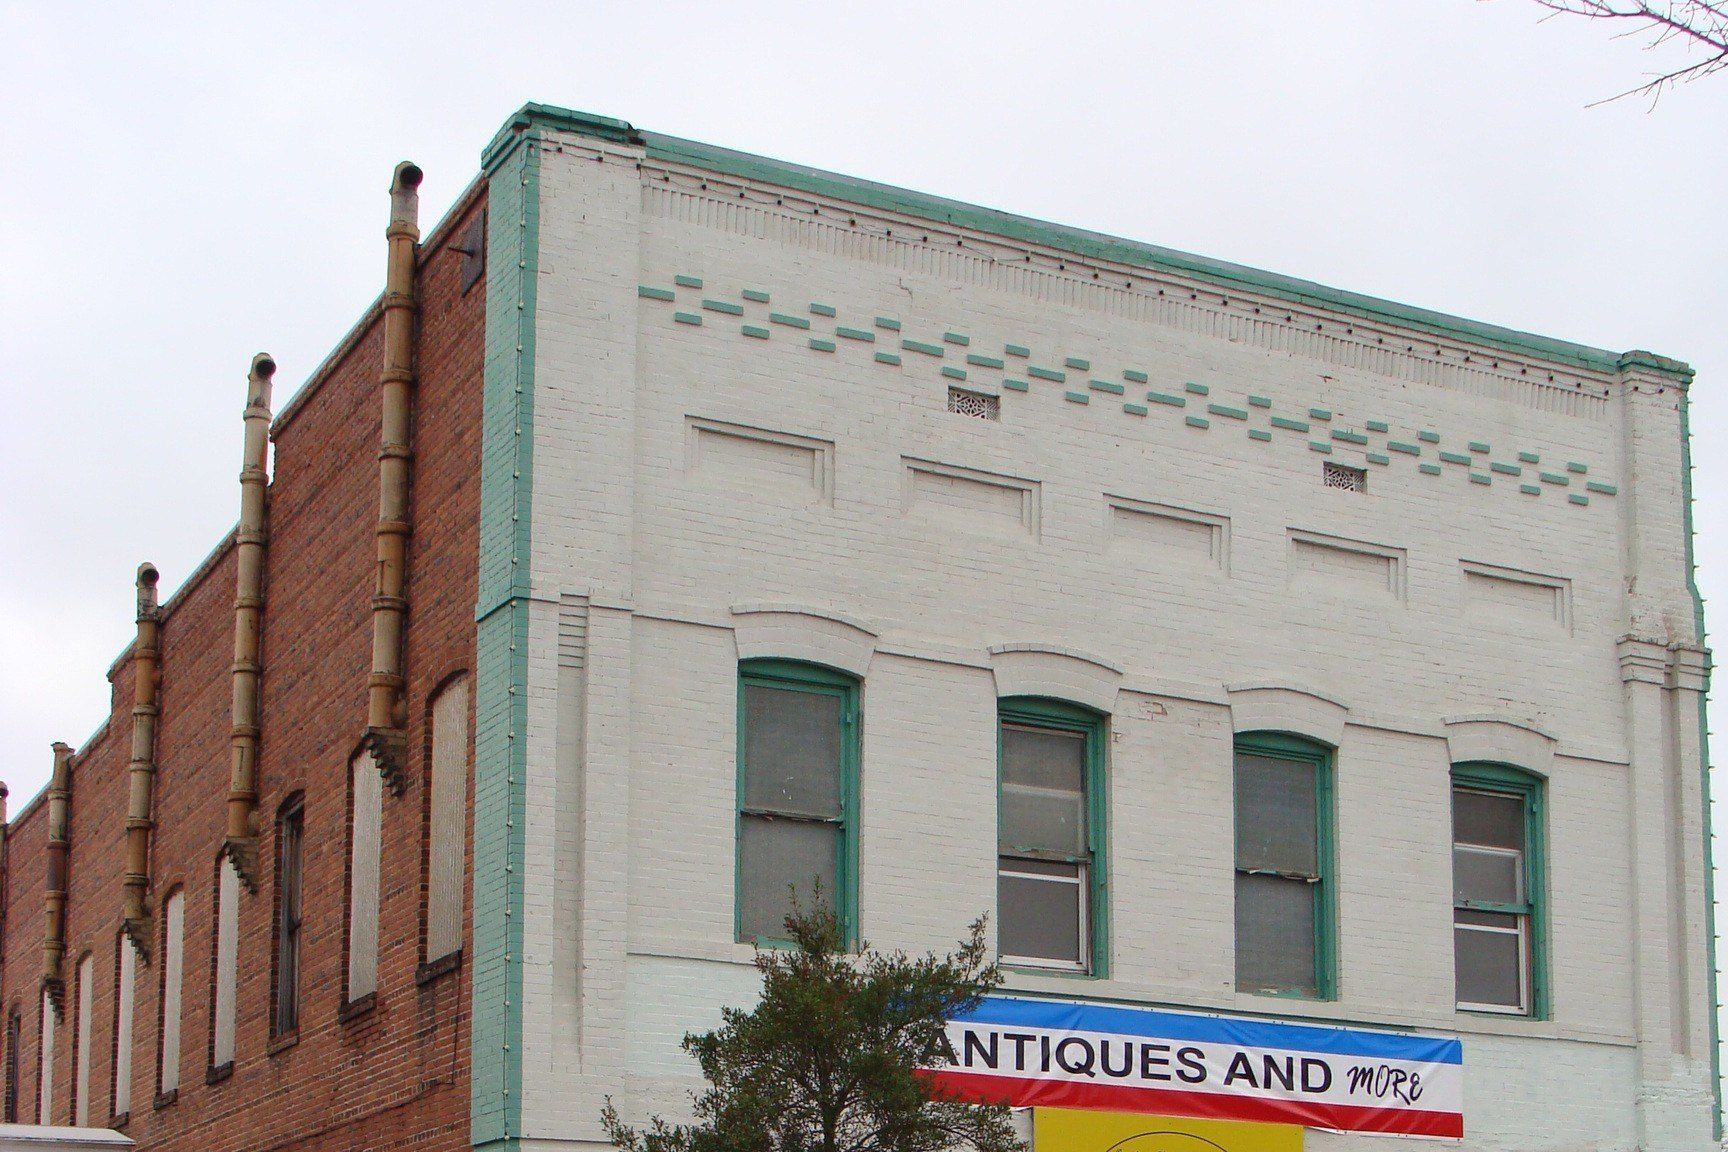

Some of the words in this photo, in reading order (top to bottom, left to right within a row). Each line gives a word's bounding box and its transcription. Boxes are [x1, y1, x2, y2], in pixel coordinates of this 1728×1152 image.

[915, 1028, 1208, 1084] ANTIQUES
[1223, 1052, 1333, 1093] AND
[1346, 1064, 1424, 1106] MORE
